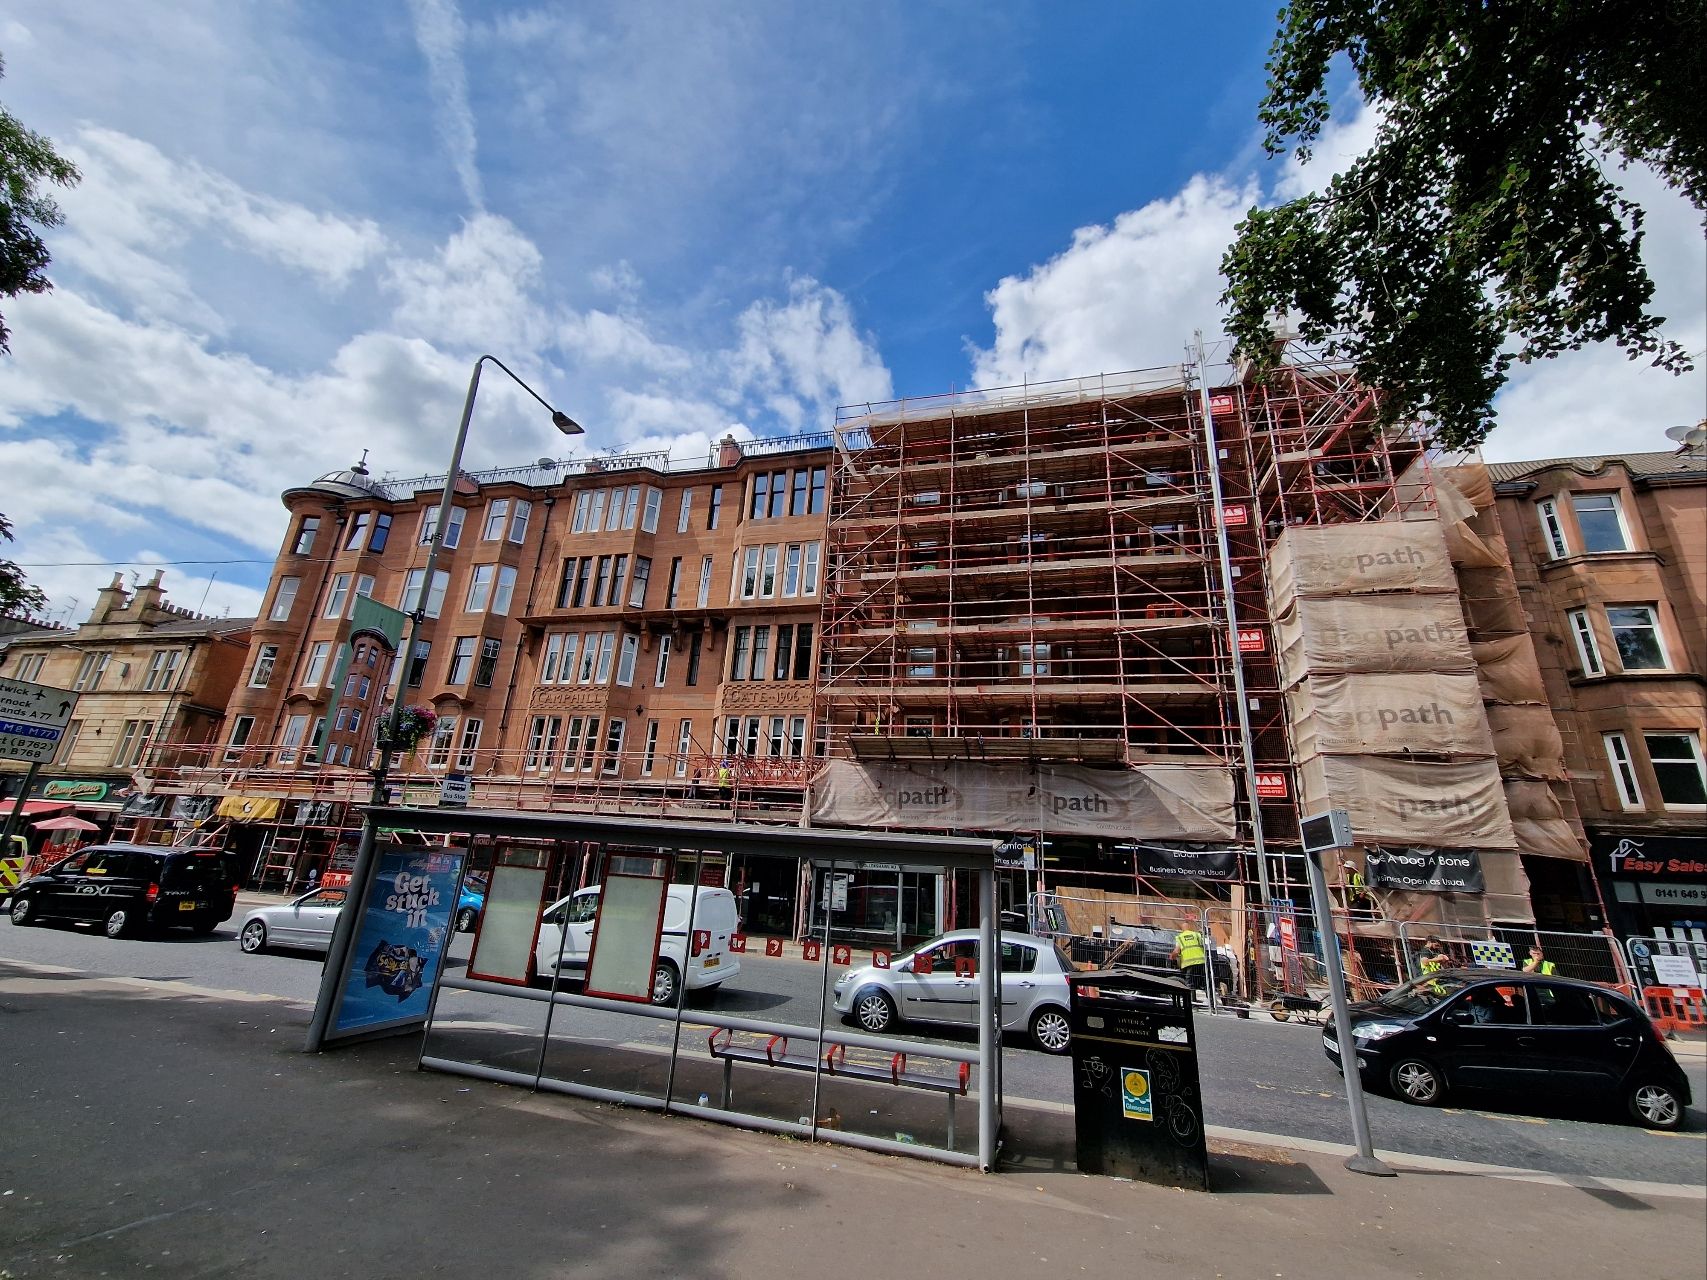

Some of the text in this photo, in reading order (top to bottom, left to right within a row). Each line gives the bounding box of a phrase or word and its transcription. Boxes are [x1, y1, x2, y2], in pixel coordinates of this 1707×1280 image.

[1223, 508, 1244, 517] AS
[1238, 632, 1260, 641] AS
[1, 697, 32, 708] rnock
[29, 711, 52, 720] A77
[28, 728, 58, 739] M77)
[11, 738, 54, 751] (B762)
[11, 748, 42, 758] B768
[999, 841, 1032, 850] omforts
[1388, 855, 1397, 864] A
[1398, 855, 1426, 868] Dog
[1428, 856, 1436, 865] A
[1438, 855, 1470, 867] Bone
[1623, 857, 1665, 874] Easy
[1149, 866, 1177, 874] Business
[1177, 867, 1197, 876] Open
[394, 872, 432, 894] Get
[1403, 876, 1428, 885] Open
[1442, 878, 1465, 886] Usual
[74, 884, 111, 897] TAXI
[1655, 888, 1678, 898] 0141
[1681, 889, 1698, 899] 649
[406, 909, 428, 928] in
